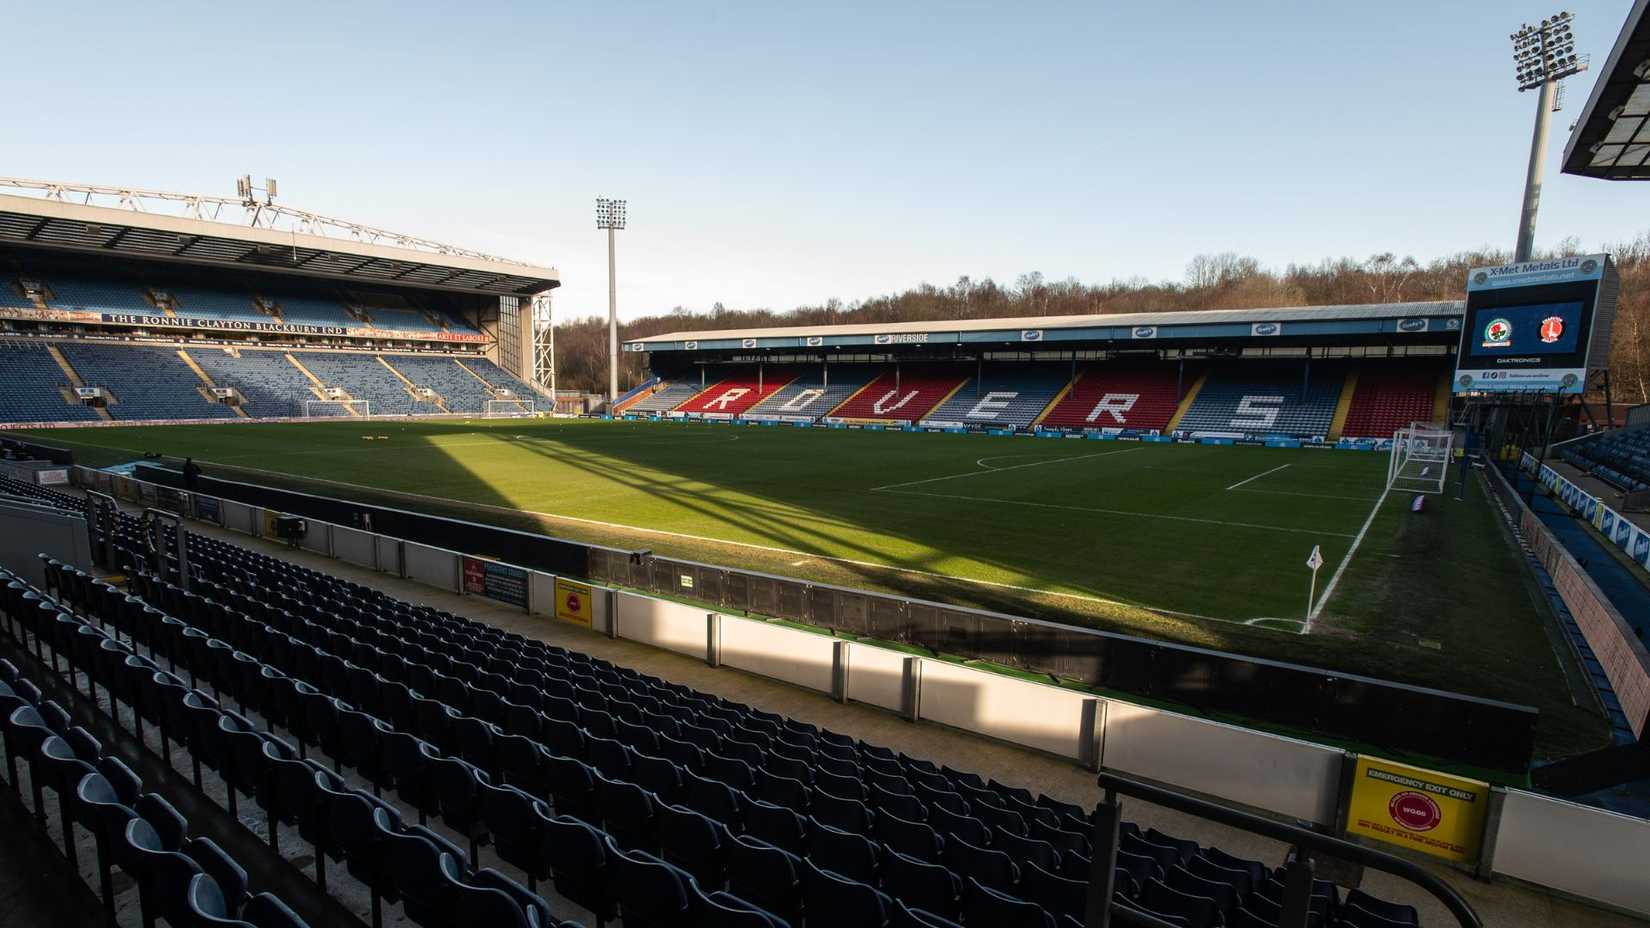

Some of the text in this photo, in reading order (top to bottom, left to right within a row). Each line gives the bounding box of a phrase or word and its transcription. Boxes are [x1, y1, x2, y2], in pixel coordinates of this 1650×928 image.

[1489, 257, 1579, 276] X-Met Metals Ltd
[109, 313, 343, 335] THE RONNIE CLAYTON BLACKBURN END
[892, 332, 929, 344] RIVERSIDE
[1368, 770, 1474, 801] EMERGENCY EXIT ONLY
